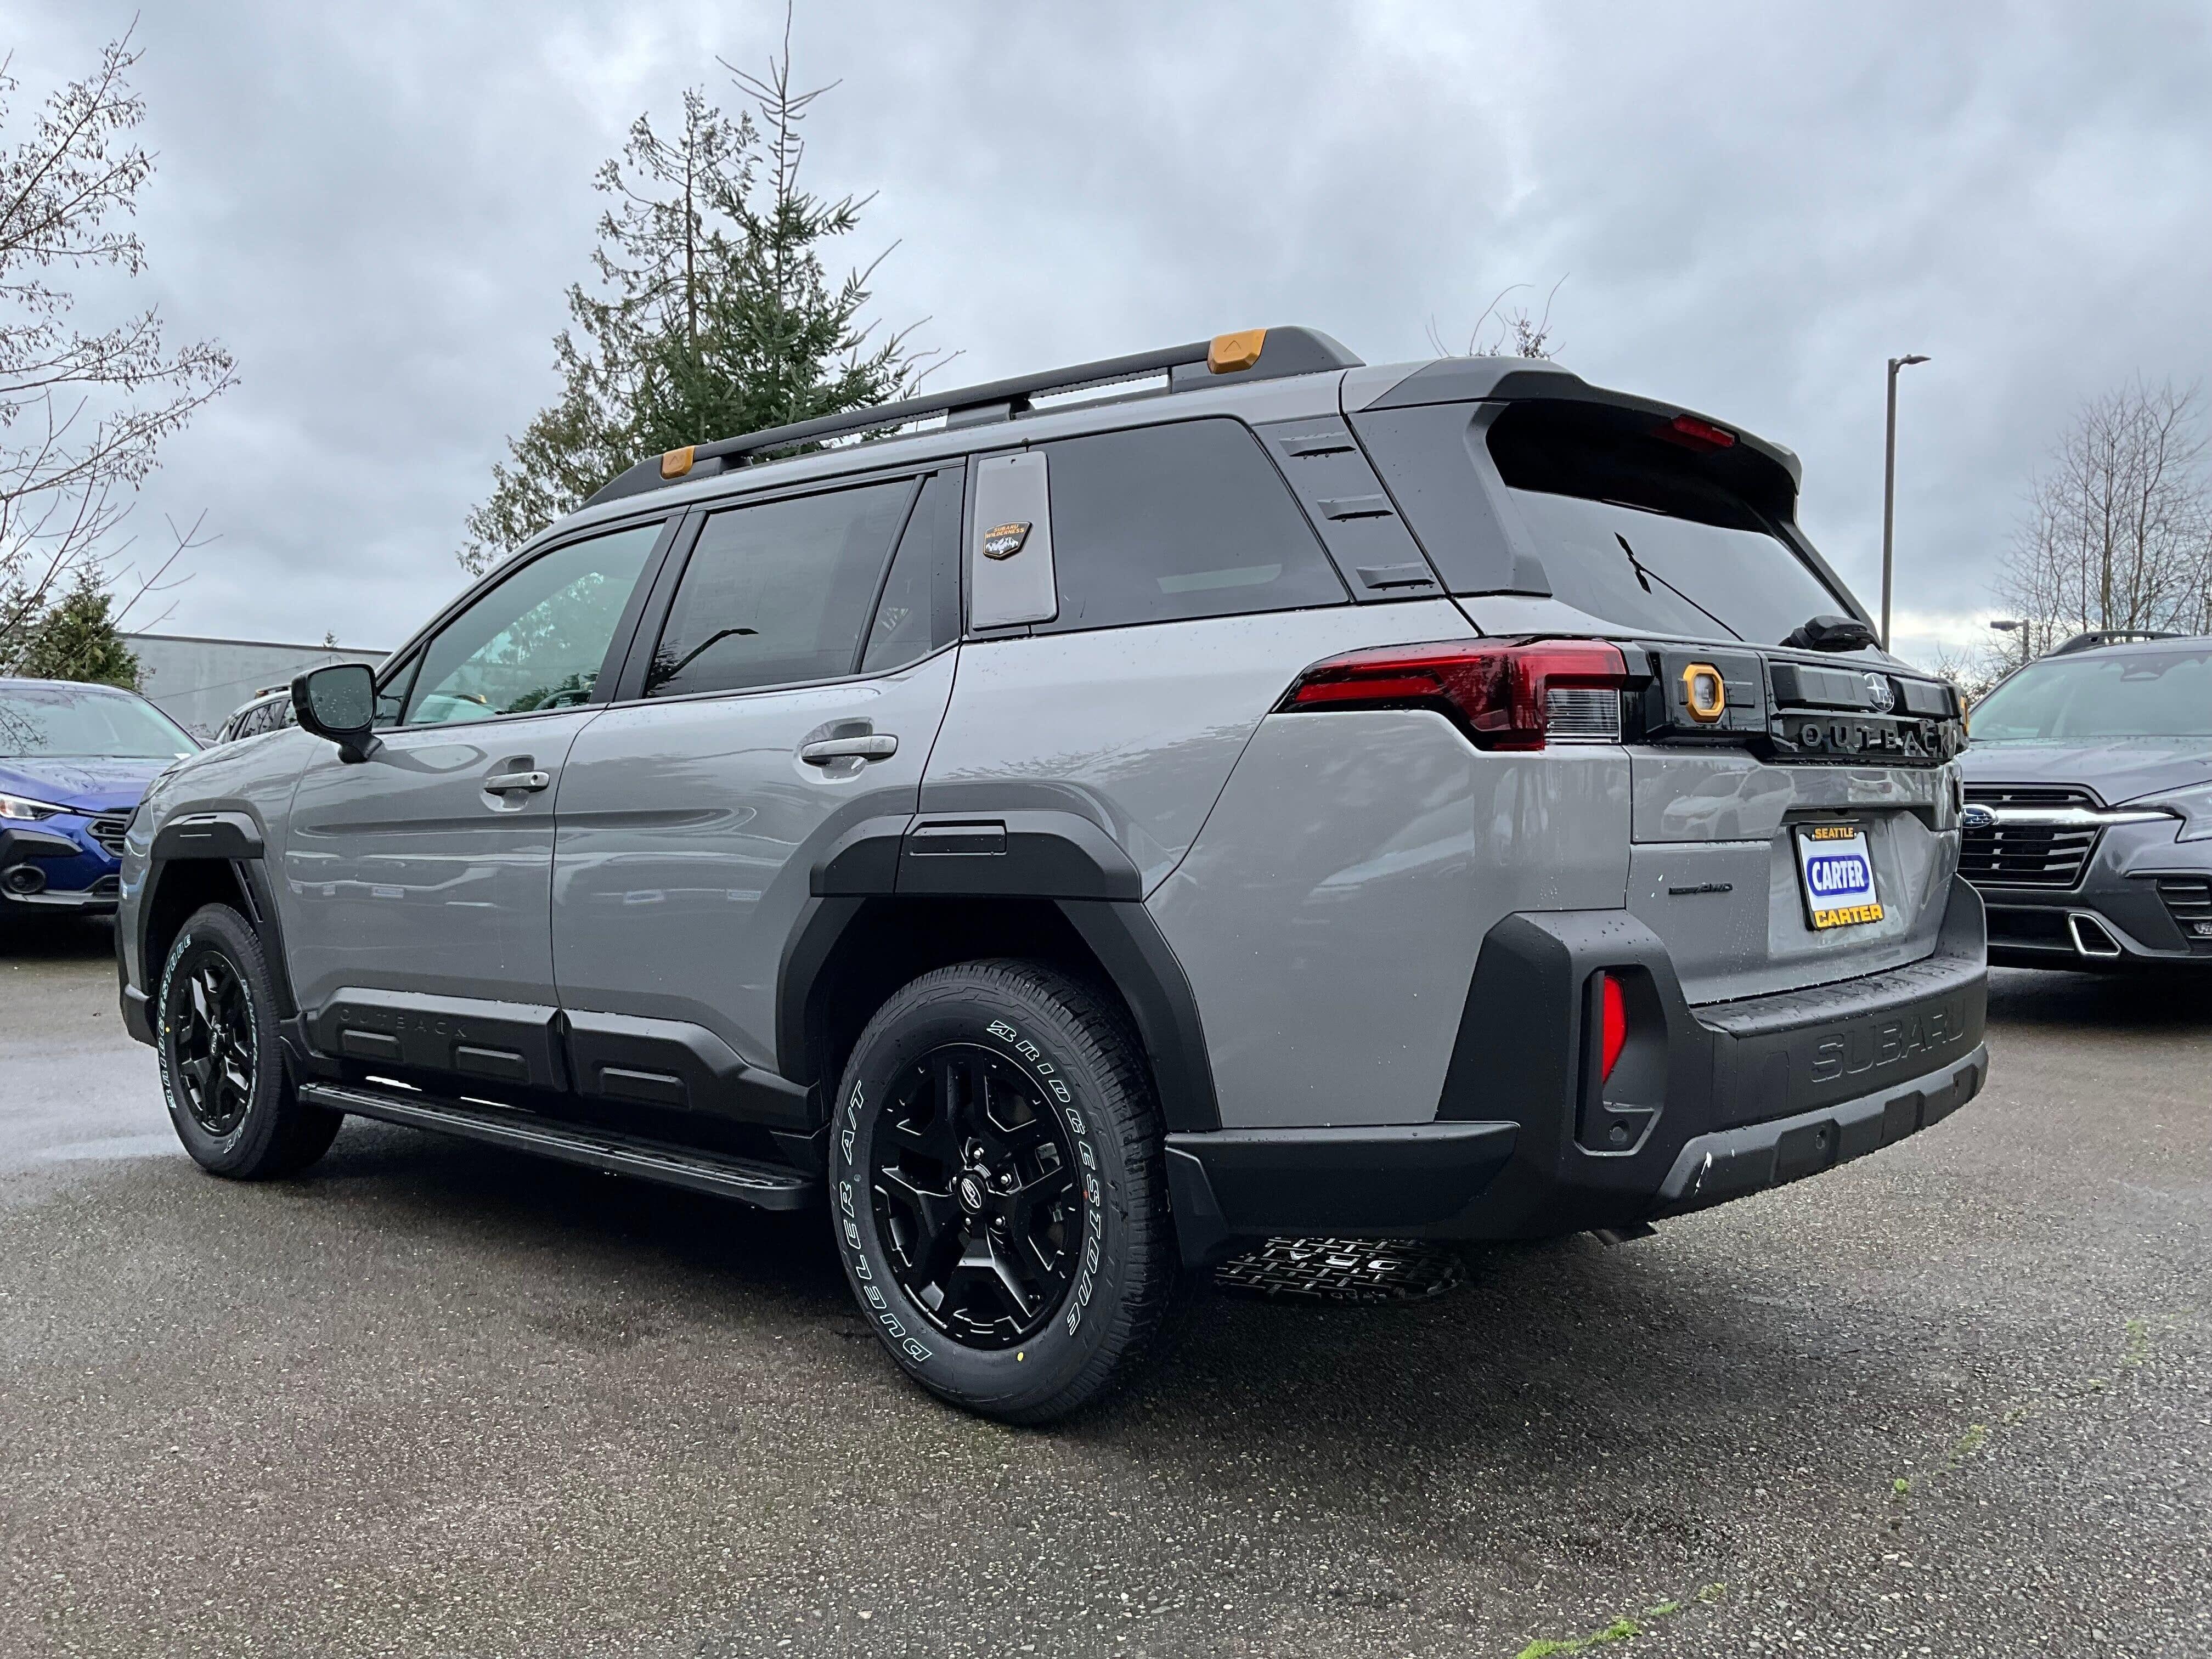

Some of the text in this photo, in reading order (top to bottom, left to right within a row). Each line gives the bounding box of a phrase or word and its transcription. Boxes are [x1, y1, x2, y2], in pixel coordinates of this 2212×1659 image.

[986, 528, 1025, 538] WILDERNESS
[994, 524, 1019, 533] SUBARU
[1801, 723, 1953, 759] OUTBACK
[1814, 827, 1854, 839] SEATTLE
[1812, 860, 1865, 891] CARTER
[1814, 904, 1883, 928] CARTER
[1811, 997, 1966, 1083] SUBARU
[986, 1019, 1101, 1336] BRIDGESTONE
[838, 1080, 933, 1363] DUELER A/T
